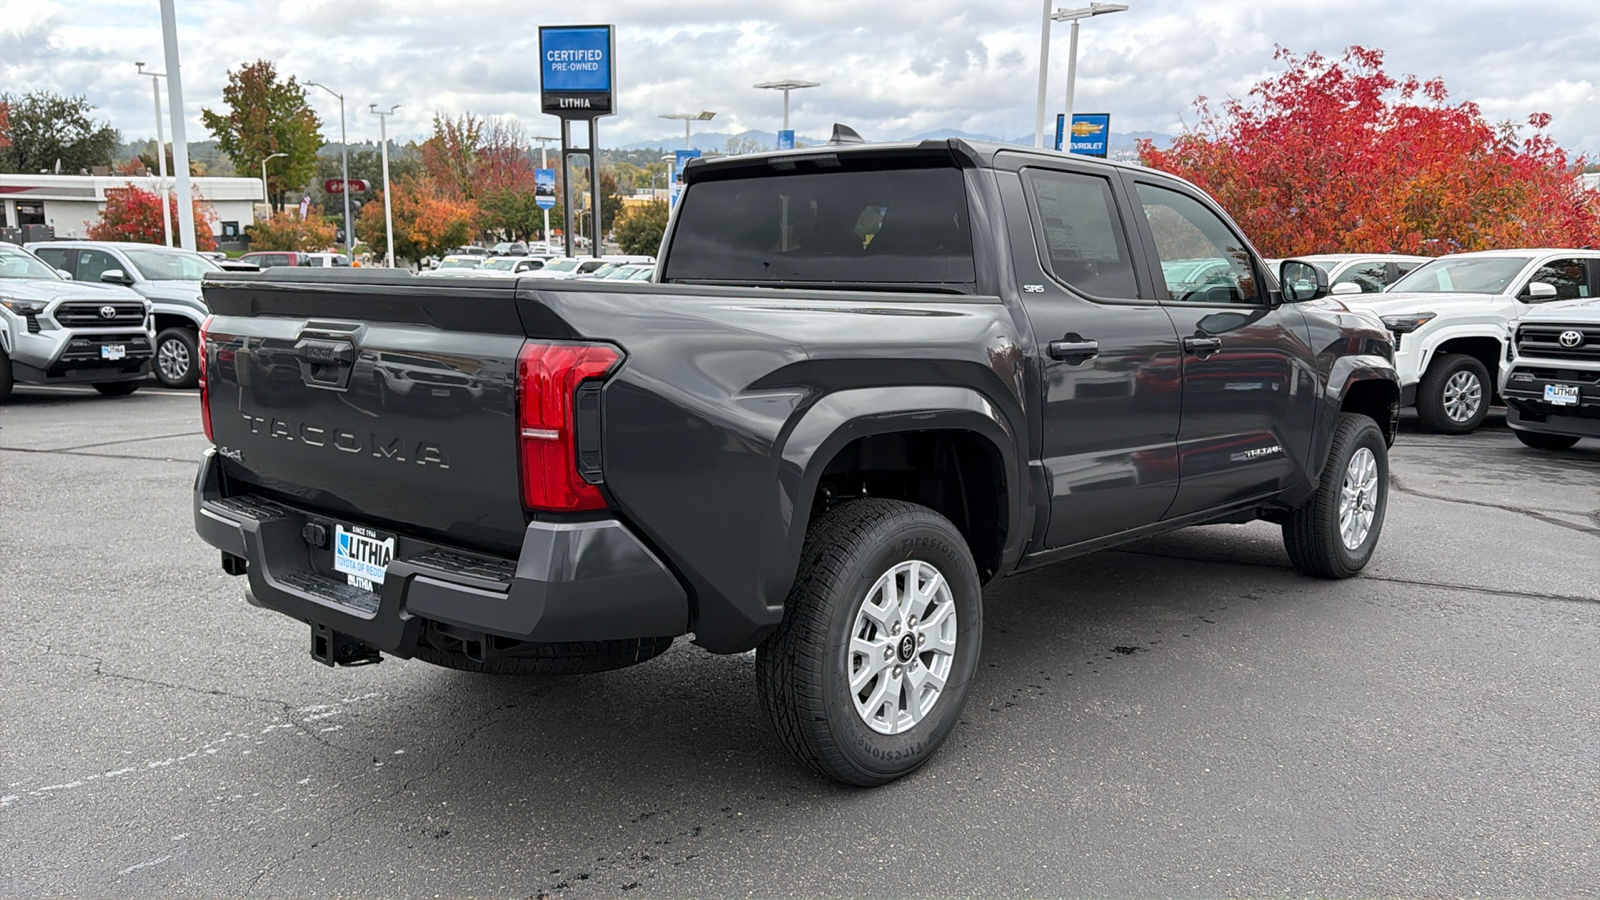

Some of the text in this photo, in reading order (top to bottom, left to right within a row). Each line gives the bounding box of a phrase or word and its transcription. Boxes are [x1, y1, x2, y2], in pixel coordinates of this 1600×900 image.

[547, 49, 602, 61] CERTIFIED
[552, 62, 598, 71] PRE-OWNED
[560, 98, 591, 108] LITHIA
[1059, 142, 1103, 150] CEVROLET
[1553, 387, 1578, 397] LITHIA
[242, 412, 450, 469] TACOMA
[352, 525, 366, 536] SINCE
[348, 536, 391, 568] LITHIA
[902, 536, 961, 568] Firestone
[337, 555, 385, 579] TOYOTA OF REDDI
[858, 733, 923, 761] Firestone
